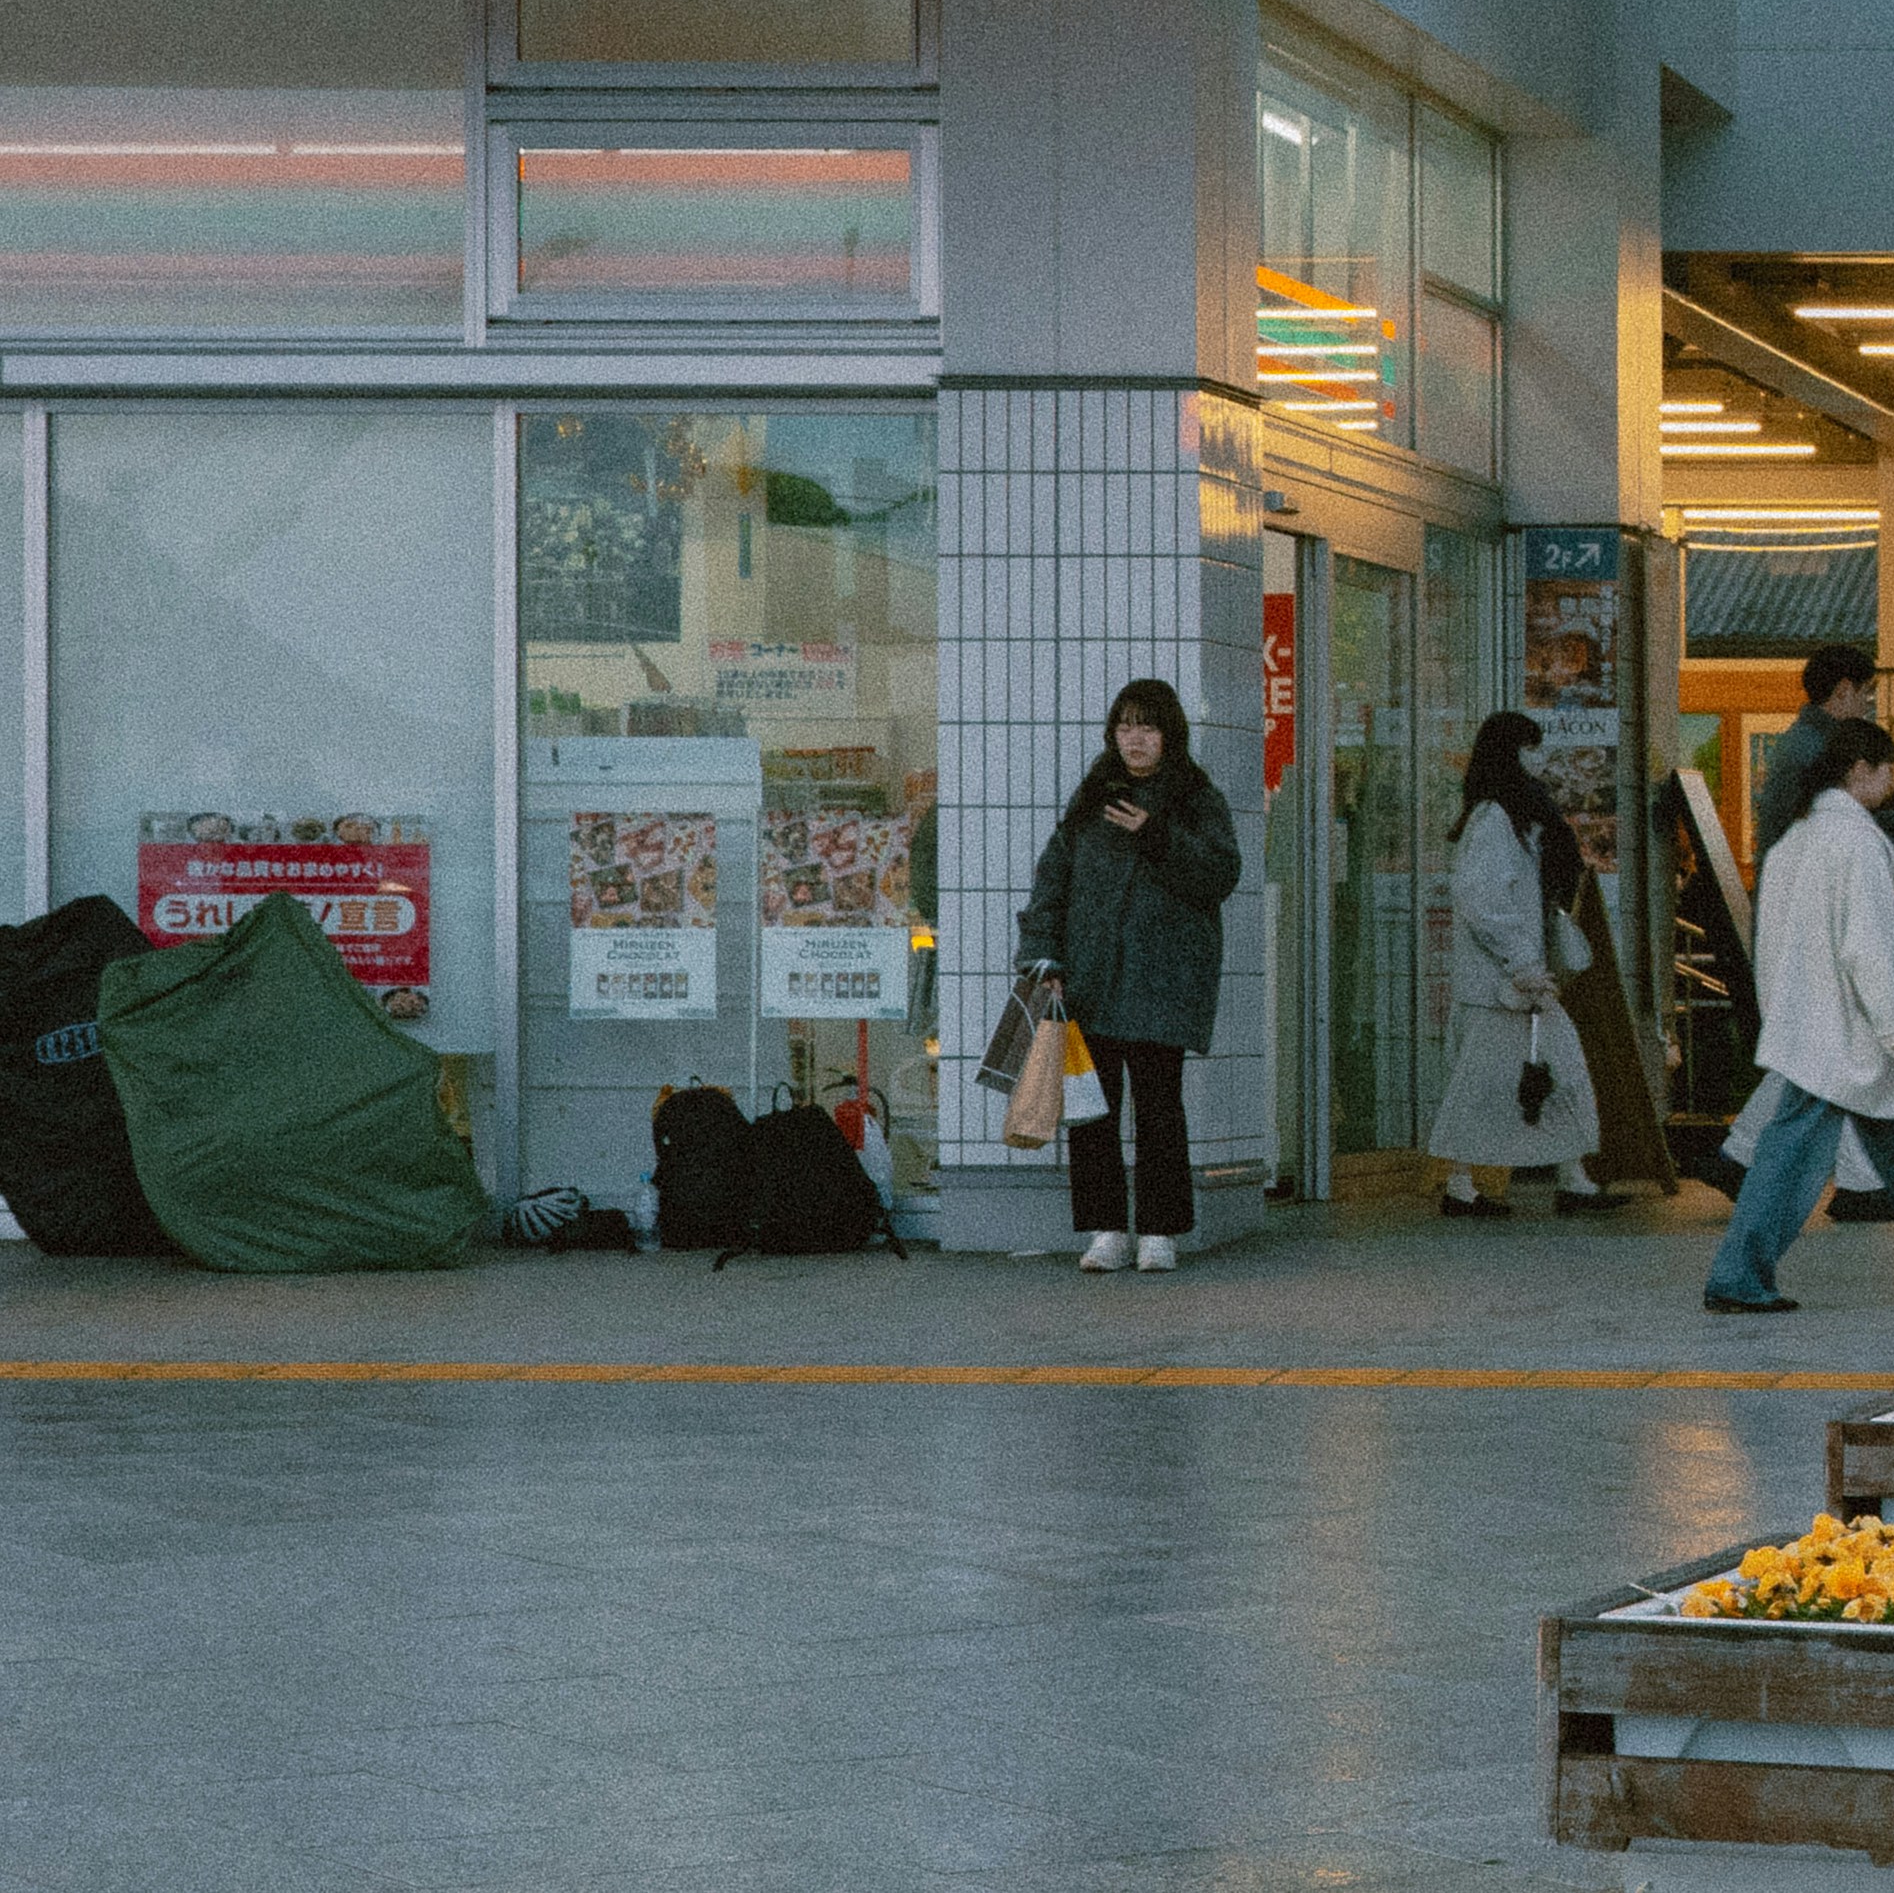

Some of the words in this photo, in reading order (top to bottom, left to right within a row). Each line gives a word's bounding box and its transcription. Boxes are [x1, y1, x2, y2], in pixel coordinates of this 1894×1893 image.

[1545, 543, 1573, 570] 2F
[606, 950, 681, 961] CHOCOLAT
[798, 949, 873, 960] CHOCOLAT
